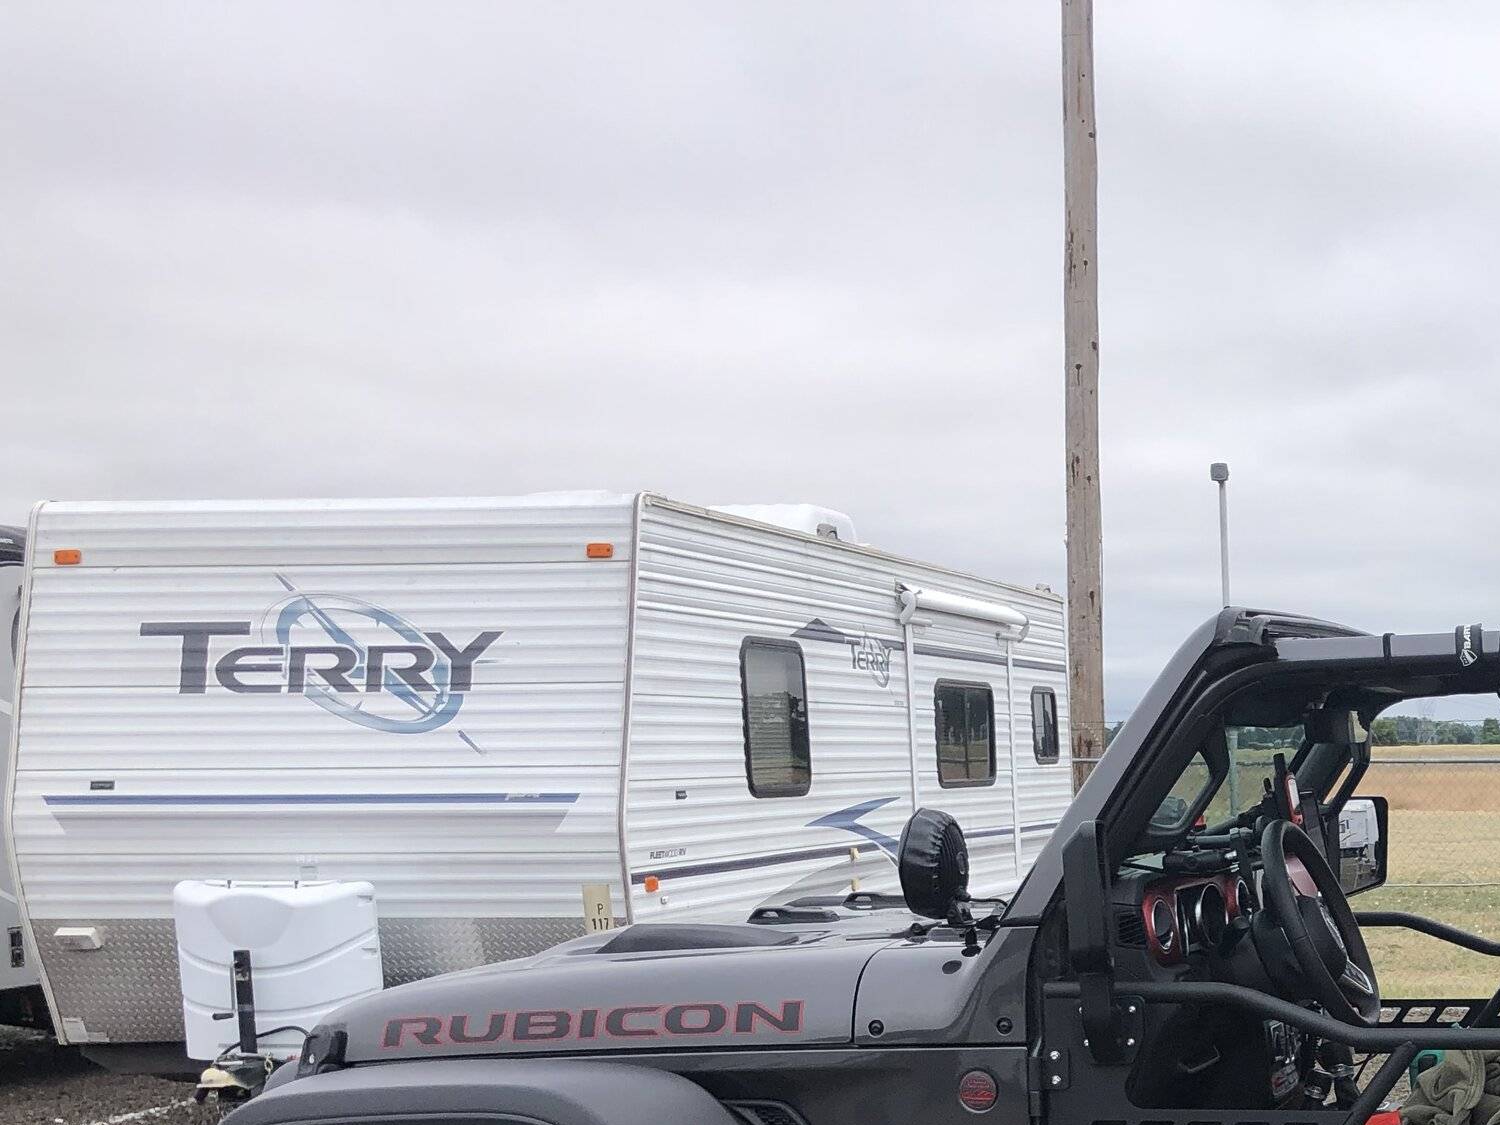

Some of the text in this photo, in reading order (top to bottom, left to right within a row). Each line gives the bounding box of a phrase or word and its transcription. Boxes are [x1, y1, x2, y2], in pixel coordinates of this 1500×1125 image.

[140, 621, 504, 694] TERRY
[844, 639, 893, 673] TERRY
[591, 917, 609, 930] 117
[597, 903, 604, 915] P
[382, 1000, 804, 1048] RUBICON
